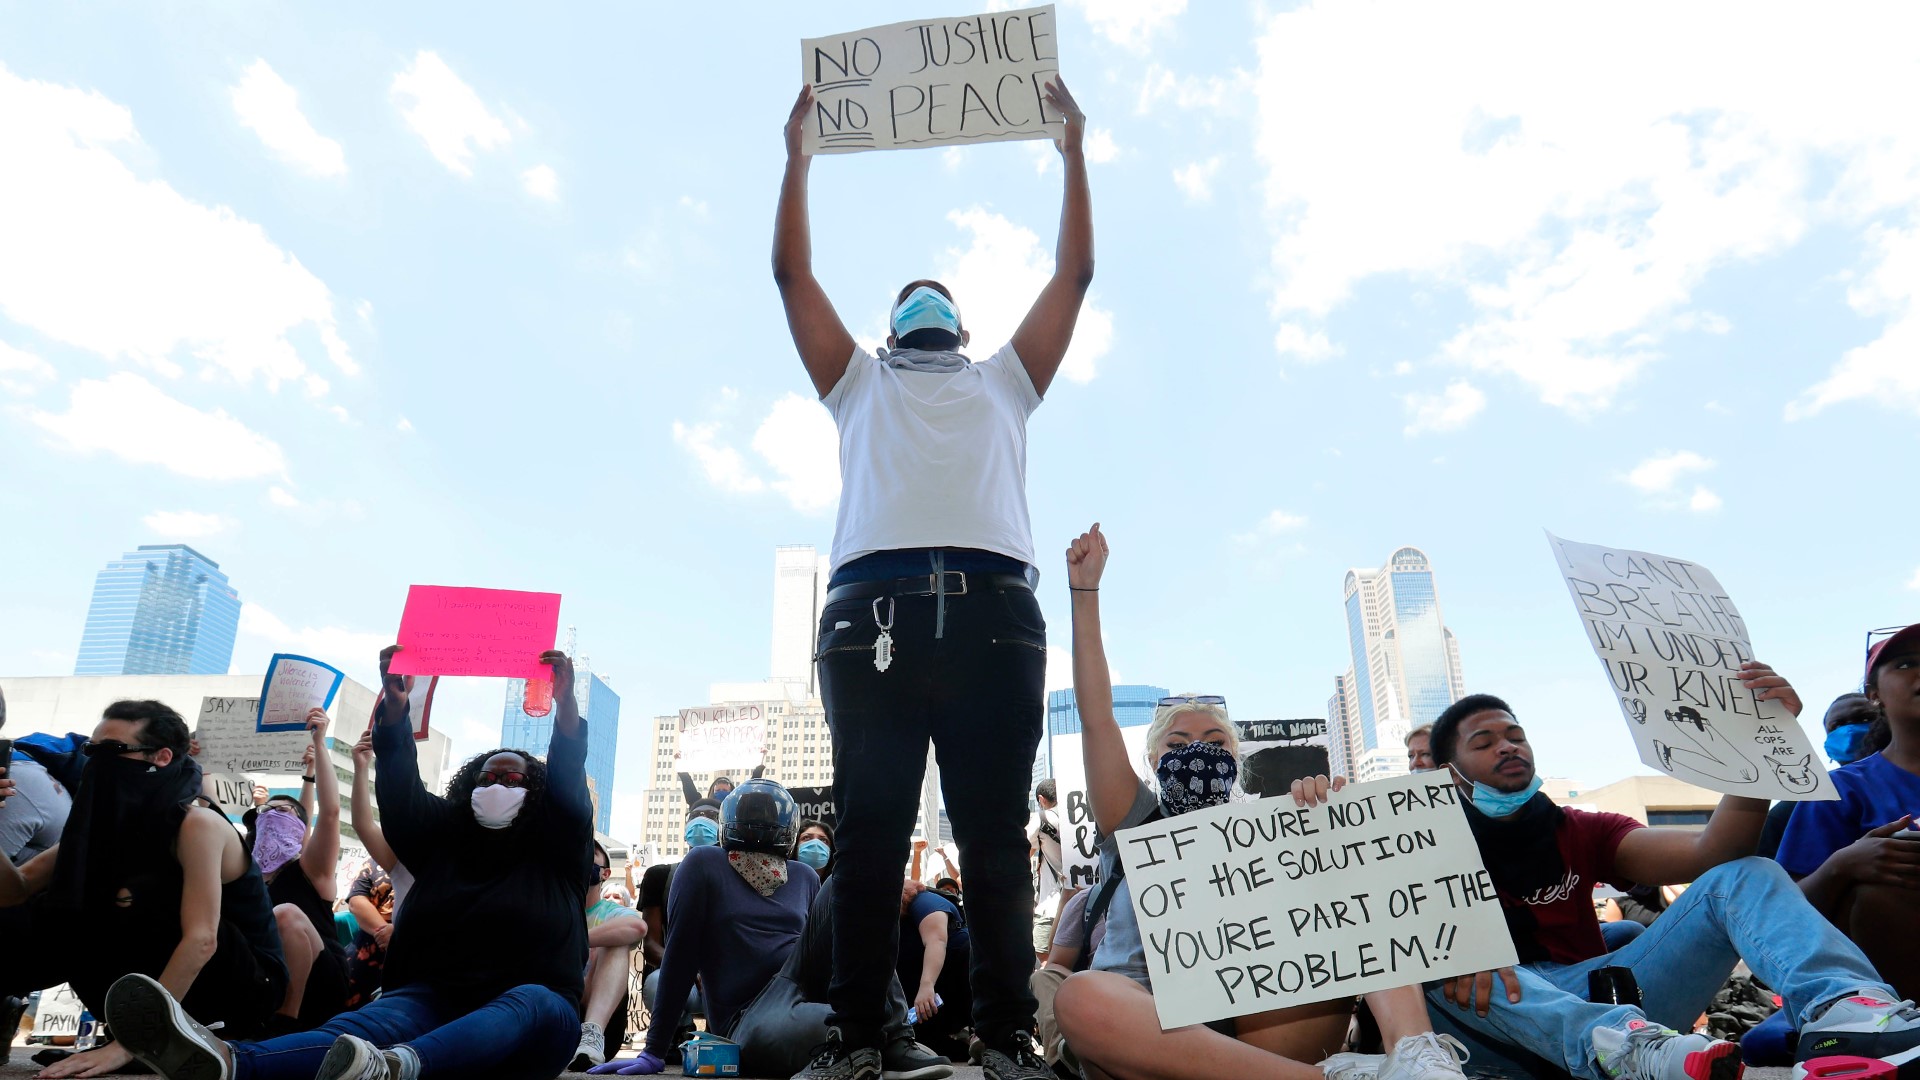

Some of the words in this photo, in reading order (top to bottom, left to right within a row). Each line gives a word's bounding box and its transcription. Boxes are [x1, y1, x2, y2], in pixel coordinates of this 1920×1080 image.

[814, 37, 882, 83] NO
[817, 98, 869, 136] NO
[889, 70, 1064, 138] PEACE
[1556, 542, 1574, 568] I
[1602, 552, 1700, 590] CANT
[1602, 657, 1655, 696] UR
[1667, 666, 1776, 720] KNEE
[204, 698, 236, 713] SAY
[679, 709, 706, 732] YOU
[712, 705, 760, 724] KILLED
[704, 726, 732, 745] VERY
[1754, 736, 1786, 744] COPS
[1757, 725, 1784, 734] ALL
[1772, 746, 1795, 755] ARE
[242, 760, 280, 769] COUNTLESS
[215, 780, 255, 807] LIVES
[1128, 825, 1198, 869] IF
[1327, 795, 1377, 831] NOT
[1388, 783, 1457, 816] PART
[1139, 877, 1187, 917] OF
[1277, 829, 1437, 880] SOLUTION
[1288, 893, 1371, 937] PART
[1389, 883, 1427, 918] OF
[1434, 869, 1499, 909] THE
[1215, 922, 1458, 1004] PROBLEM!!
[1823, 1038, 1838, 1048] MAX
